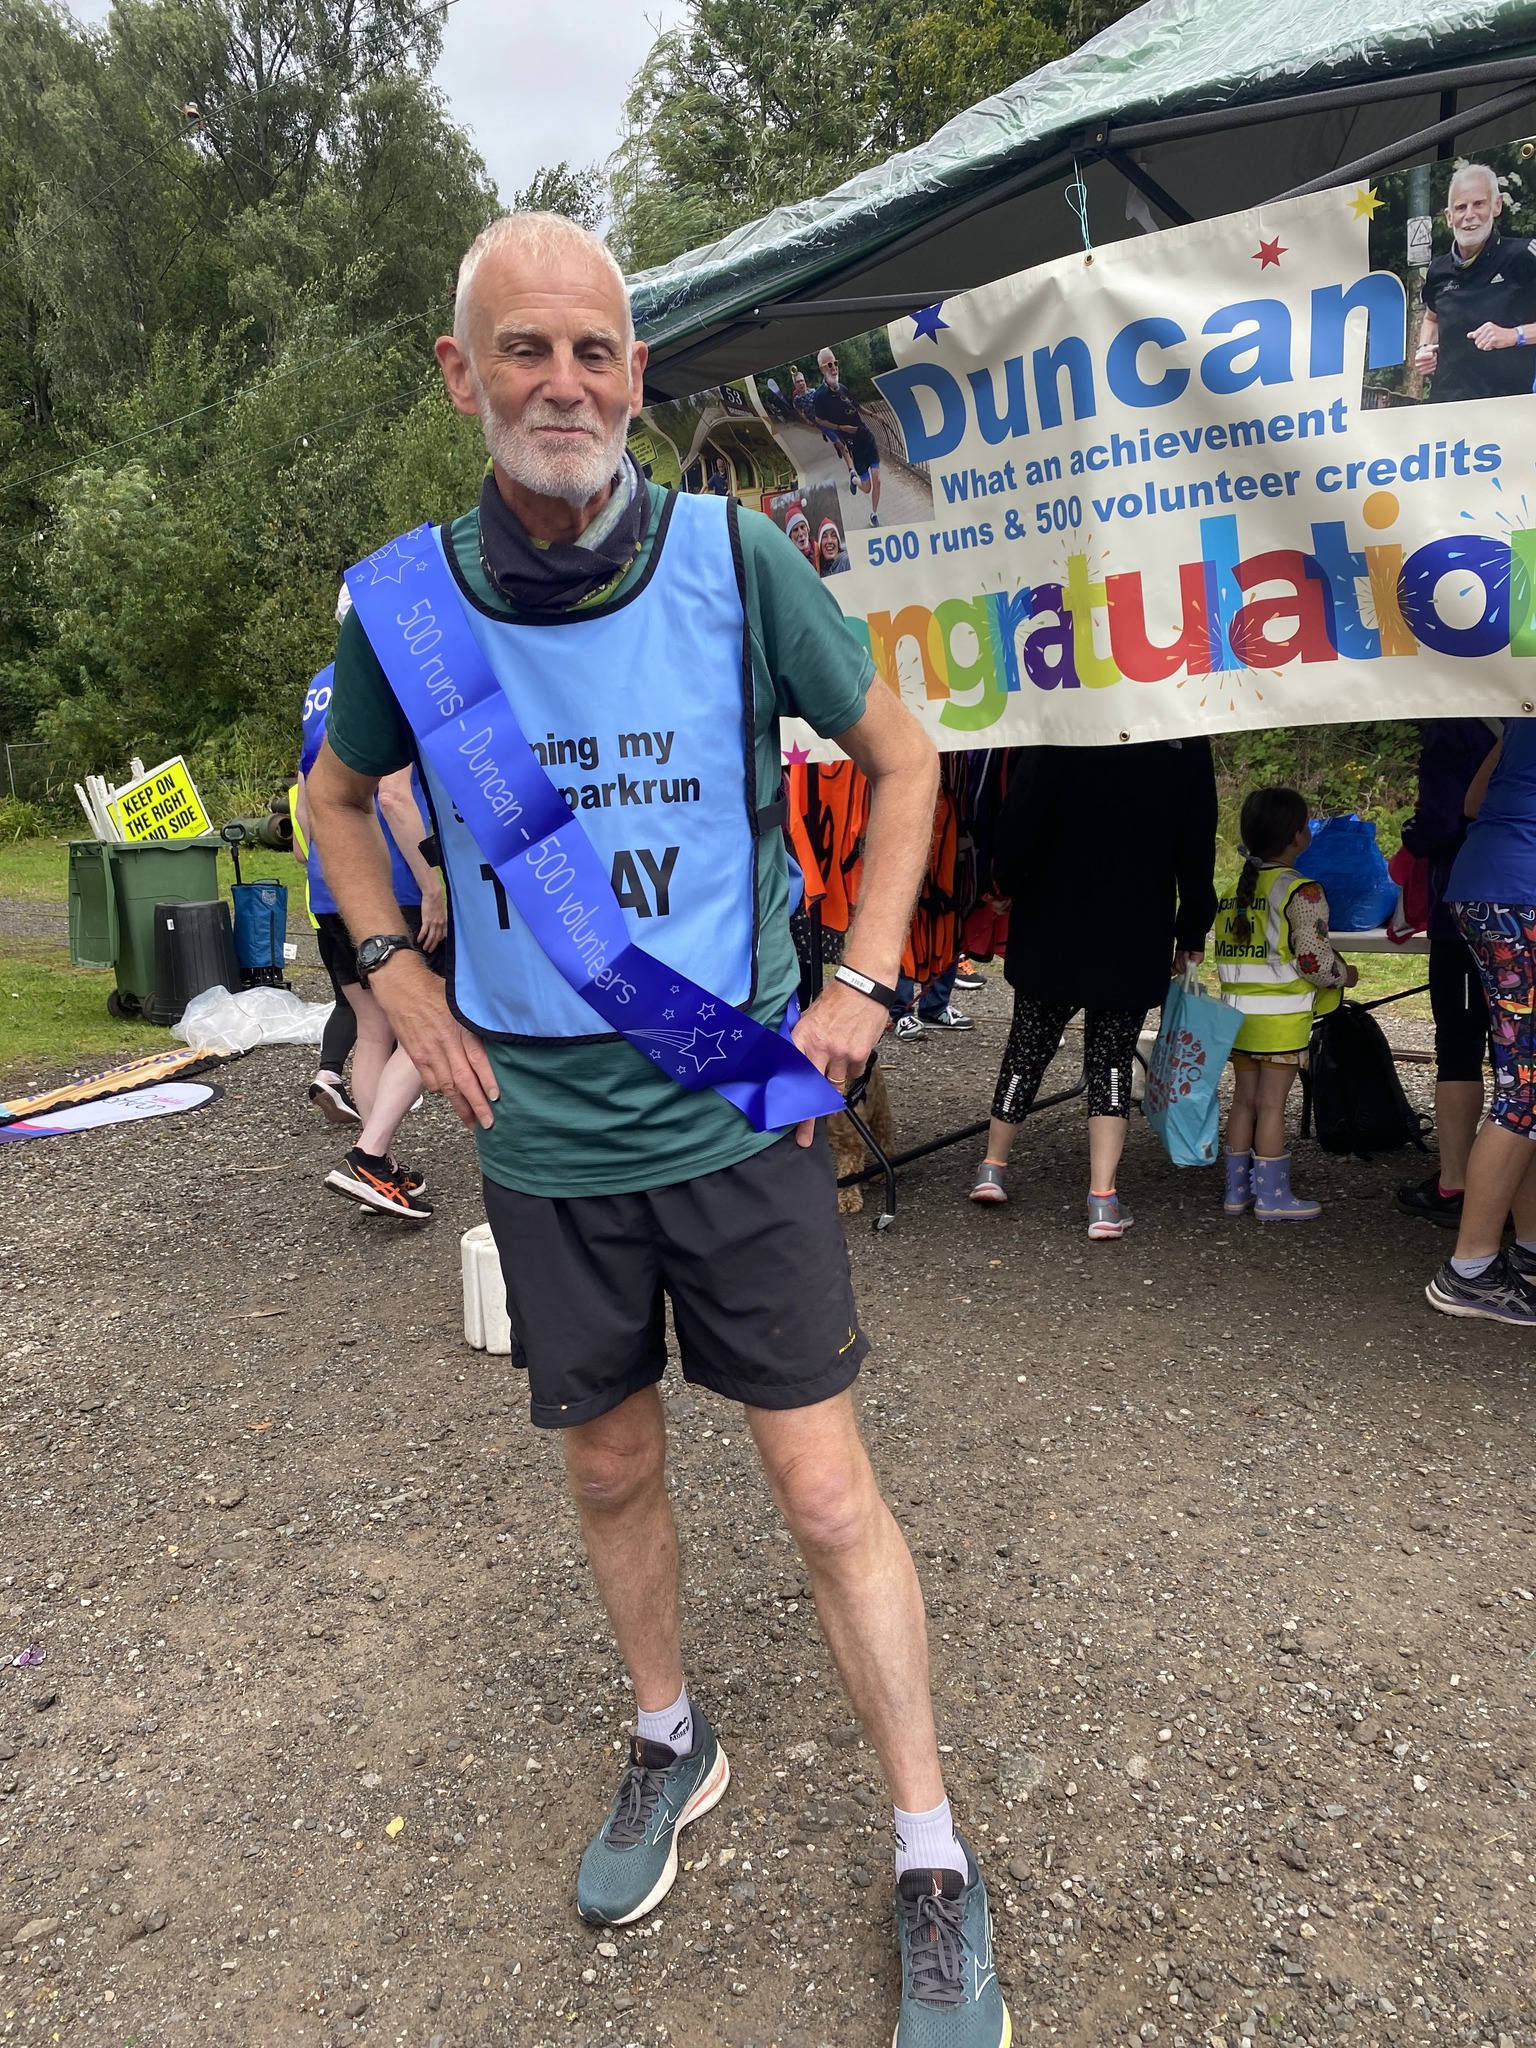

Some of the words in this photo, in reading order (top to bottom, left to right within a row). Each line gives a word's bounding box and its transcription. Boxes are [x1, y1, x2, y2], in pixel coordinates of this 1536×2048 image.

[875, 273, 1405, 465] Duncan
[726, 387, 742, 405] 53
[940, 460, 1017, 504] What
[1025, 455, 1062, 486] an
[1070, 397, 1348, 476] achievement
[868, 530, 920, 566] 500
[930, 522, 994, 555] runs
[1004, 509, 1026, 540] &
[1036, 495, 1082, 534] 500
[1092, 470, 1300, 522] volunteer
[1315, 438, 1502, 492] credits
[844, 491, 1536, 732] ngratulatio
[529, 733, 599, 770] ning
[618, 731, 675, 764] my
[123, 786, 153, 816] KEEP
[156, 773, 175, 795] ON
[126, 812, 152, 837] THE
[151, 789, 187, 822] RIGHT
[397, 599, 442, 655] 500
[420, 653, 464, 716] runs
[459, 727, 523, 827] Duncan
[525, 836, 575, 894] 500
[556, 892, 637, 1004] volunteers
[558, 773, 700, 811] parkrun
[137, 824, 169, 841] AND
[168, 806, 198, 833] SIDE
[1217, 897, 1266, 914] parun
[1215, 940, 1267, 958] Marshal
